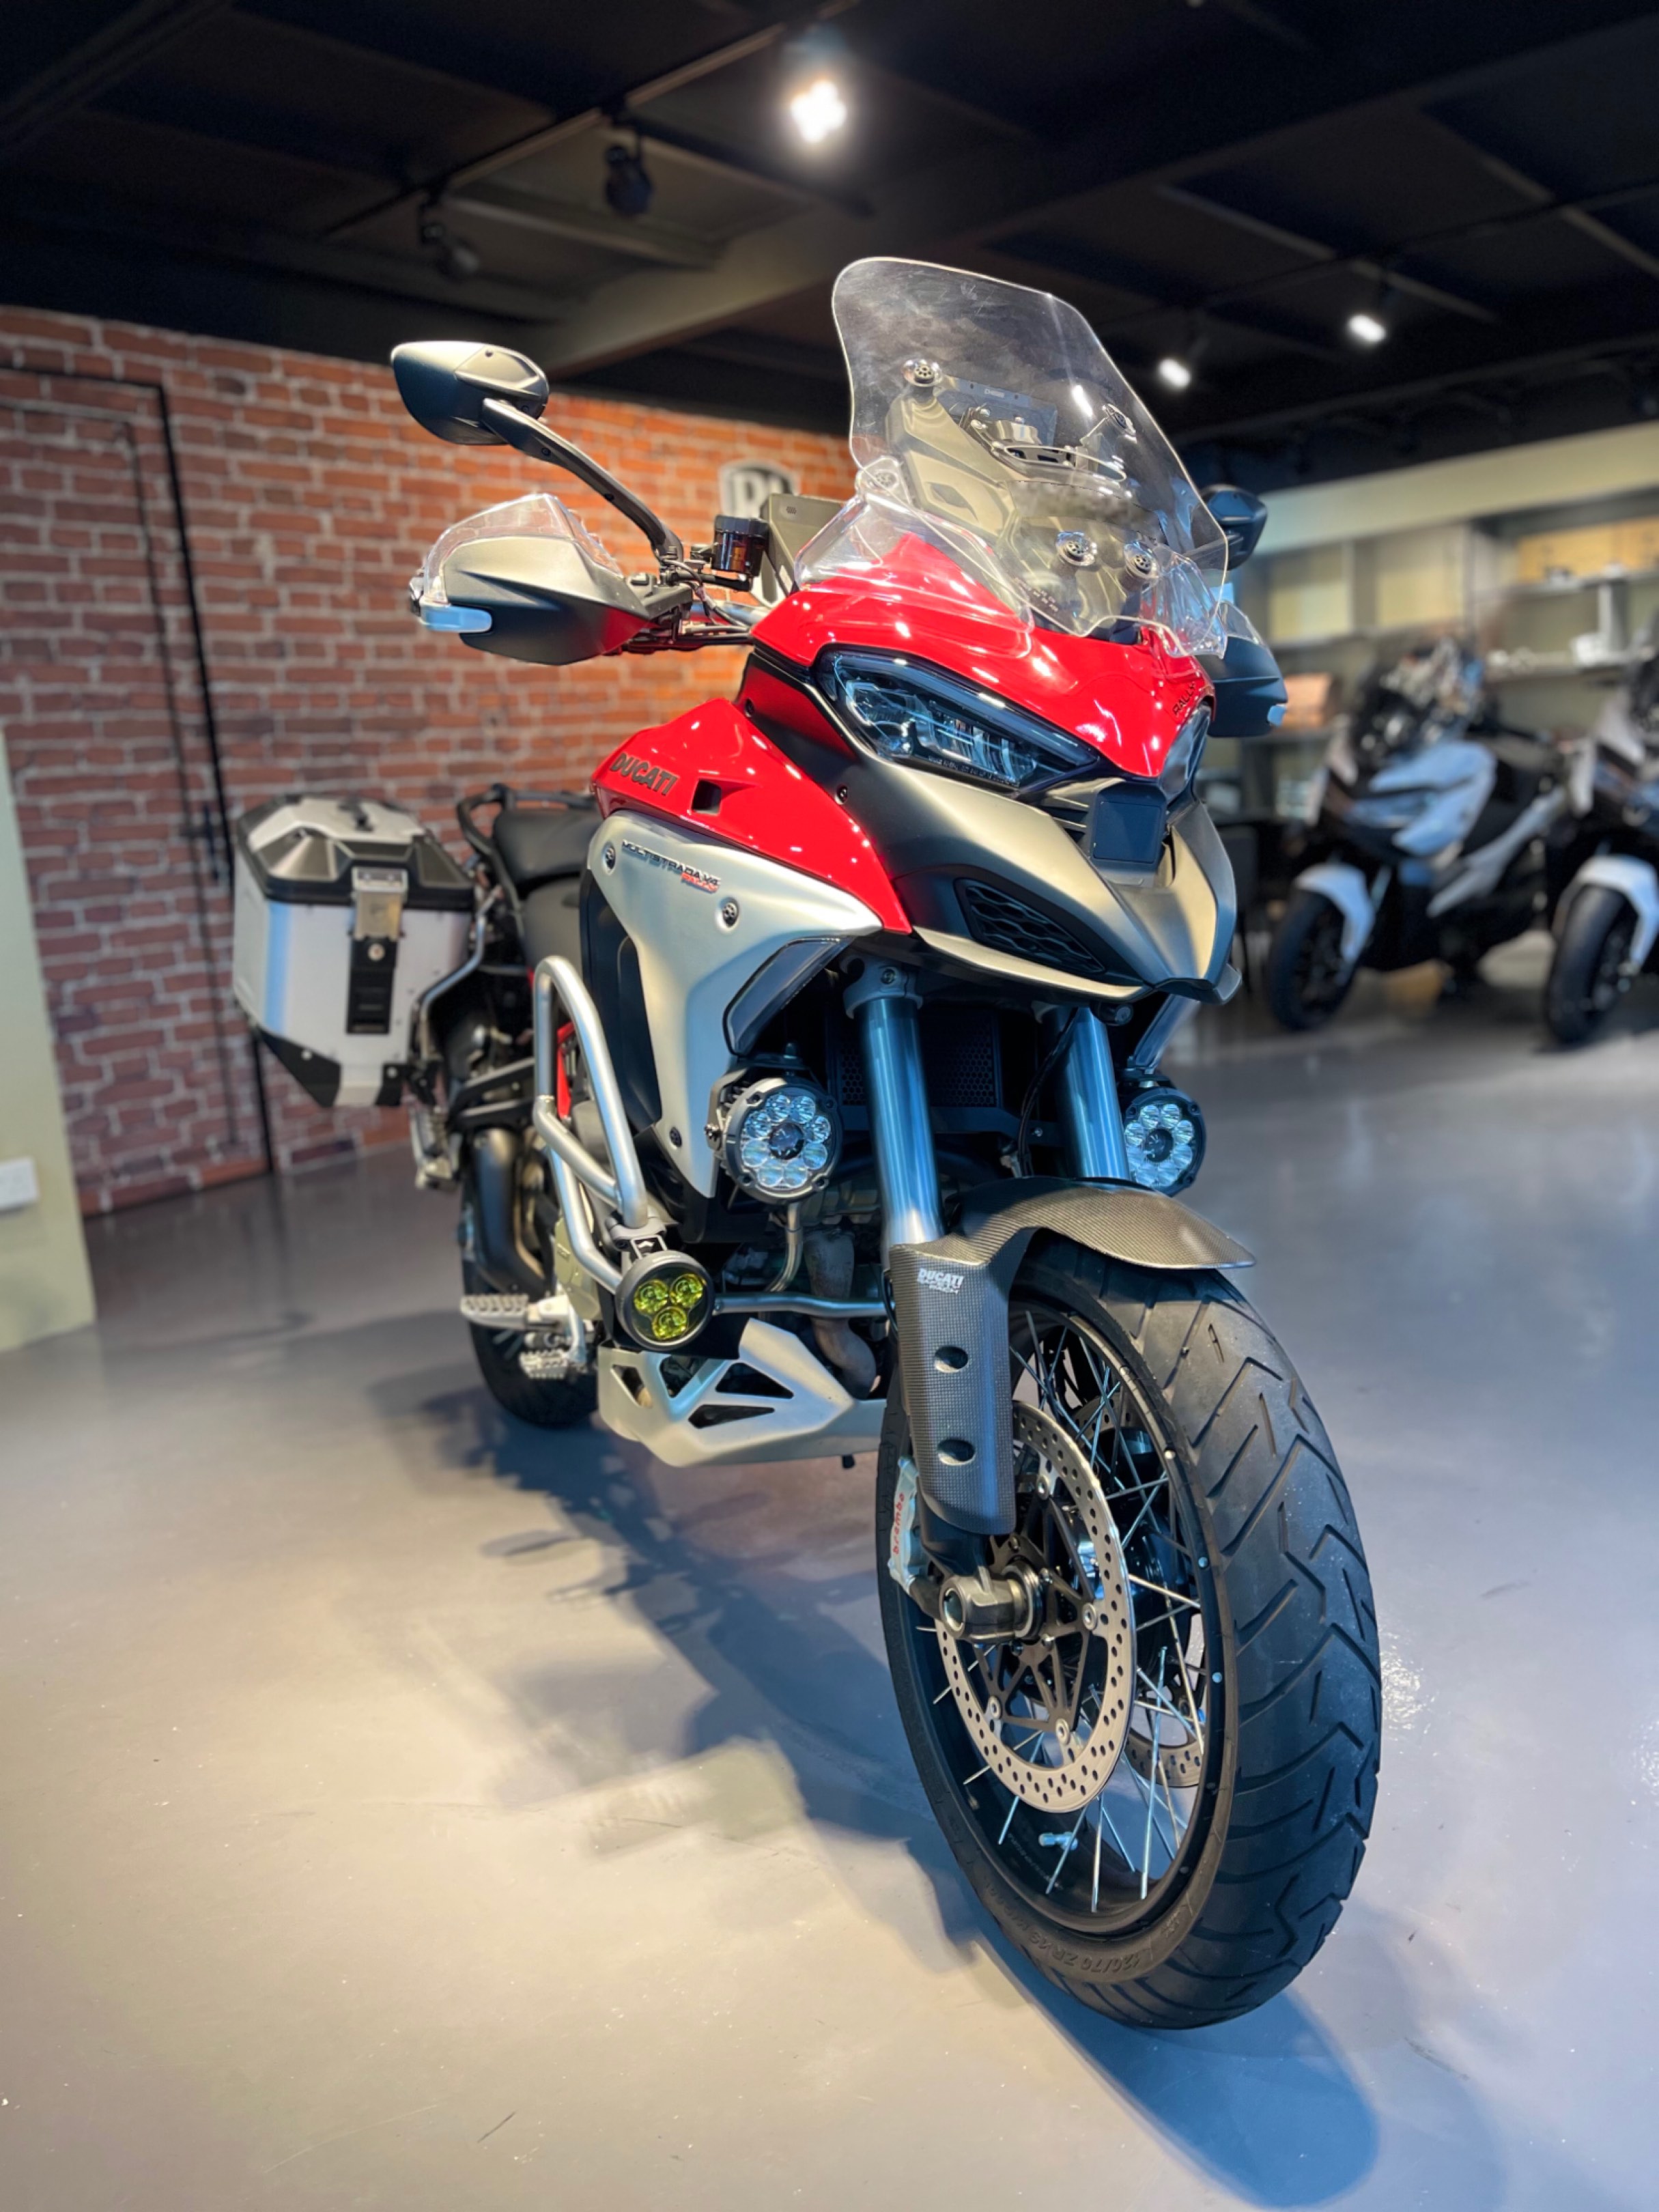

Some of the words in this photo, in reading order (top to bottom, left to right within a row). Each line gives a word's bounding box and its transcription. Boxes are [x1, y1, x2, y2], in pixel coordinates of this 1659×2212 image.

[1173, 683, 1195, 715] RALLY
[610, 752, 679, 795] DUCATI
[621, 840, 702, 880] MULTISTRADA
[703, 871, 721, 885] V4
[918, 1268, 964, 1290] DUCATI
[892, 1492, 905, 1555] brembo
